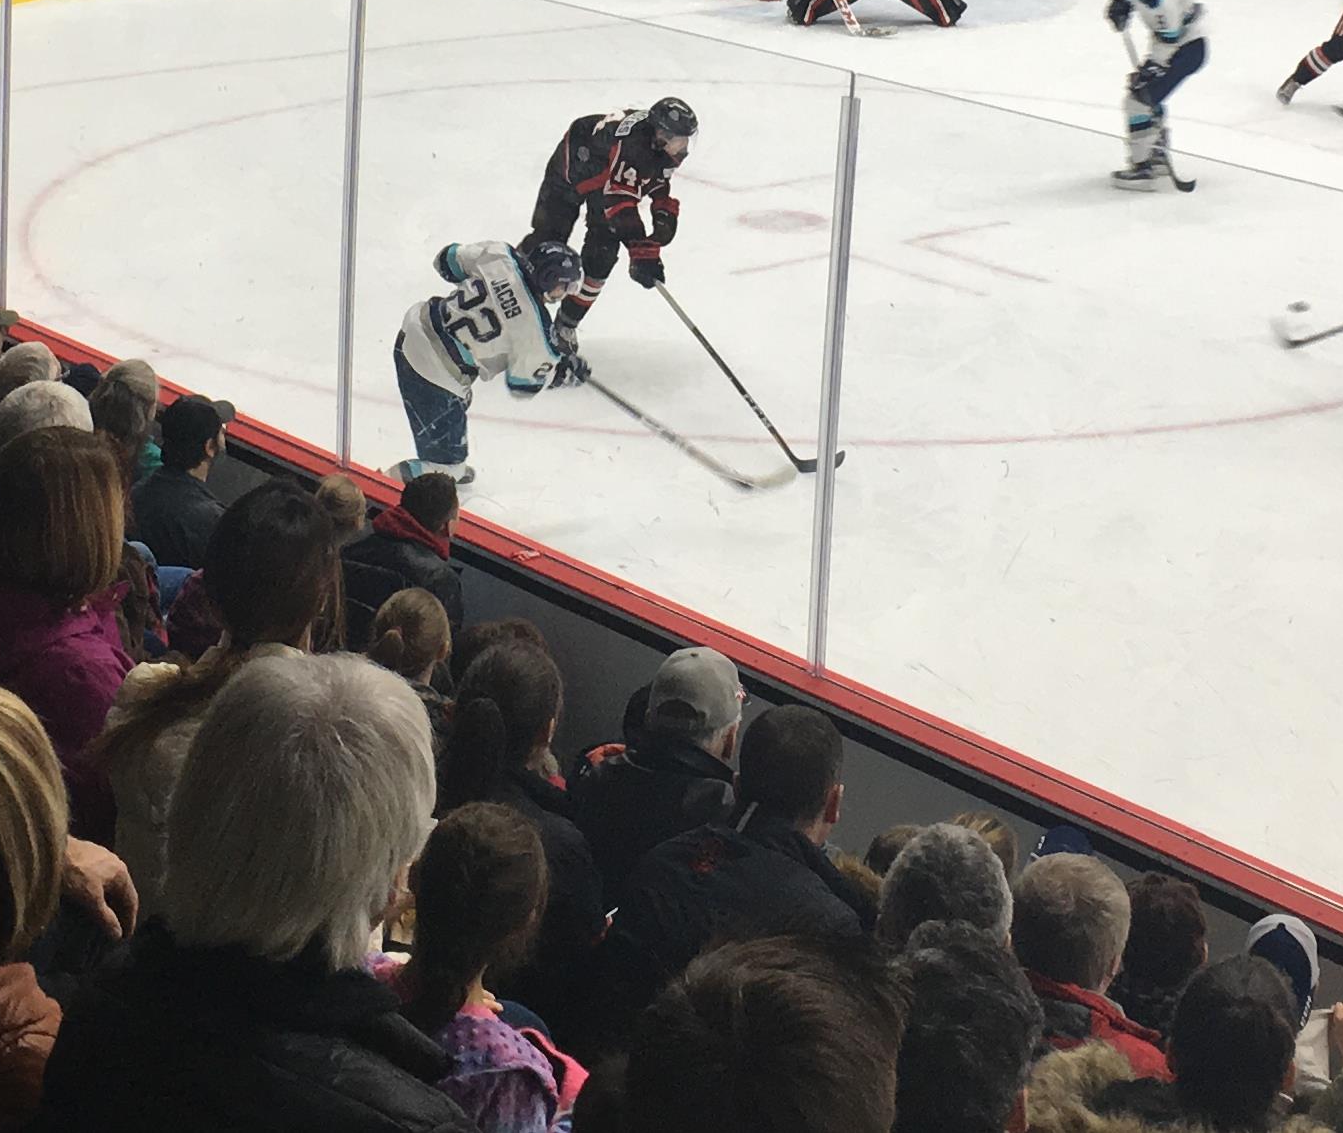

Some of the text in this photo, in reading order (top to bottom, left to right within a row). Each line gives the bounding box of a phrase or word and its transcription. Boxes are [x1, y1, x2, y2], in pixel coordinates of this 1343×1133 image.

[615, 161, 640, 188] 14
[439, 279, 503, 350] 22
[490, 278, 523, 320] JACOB
